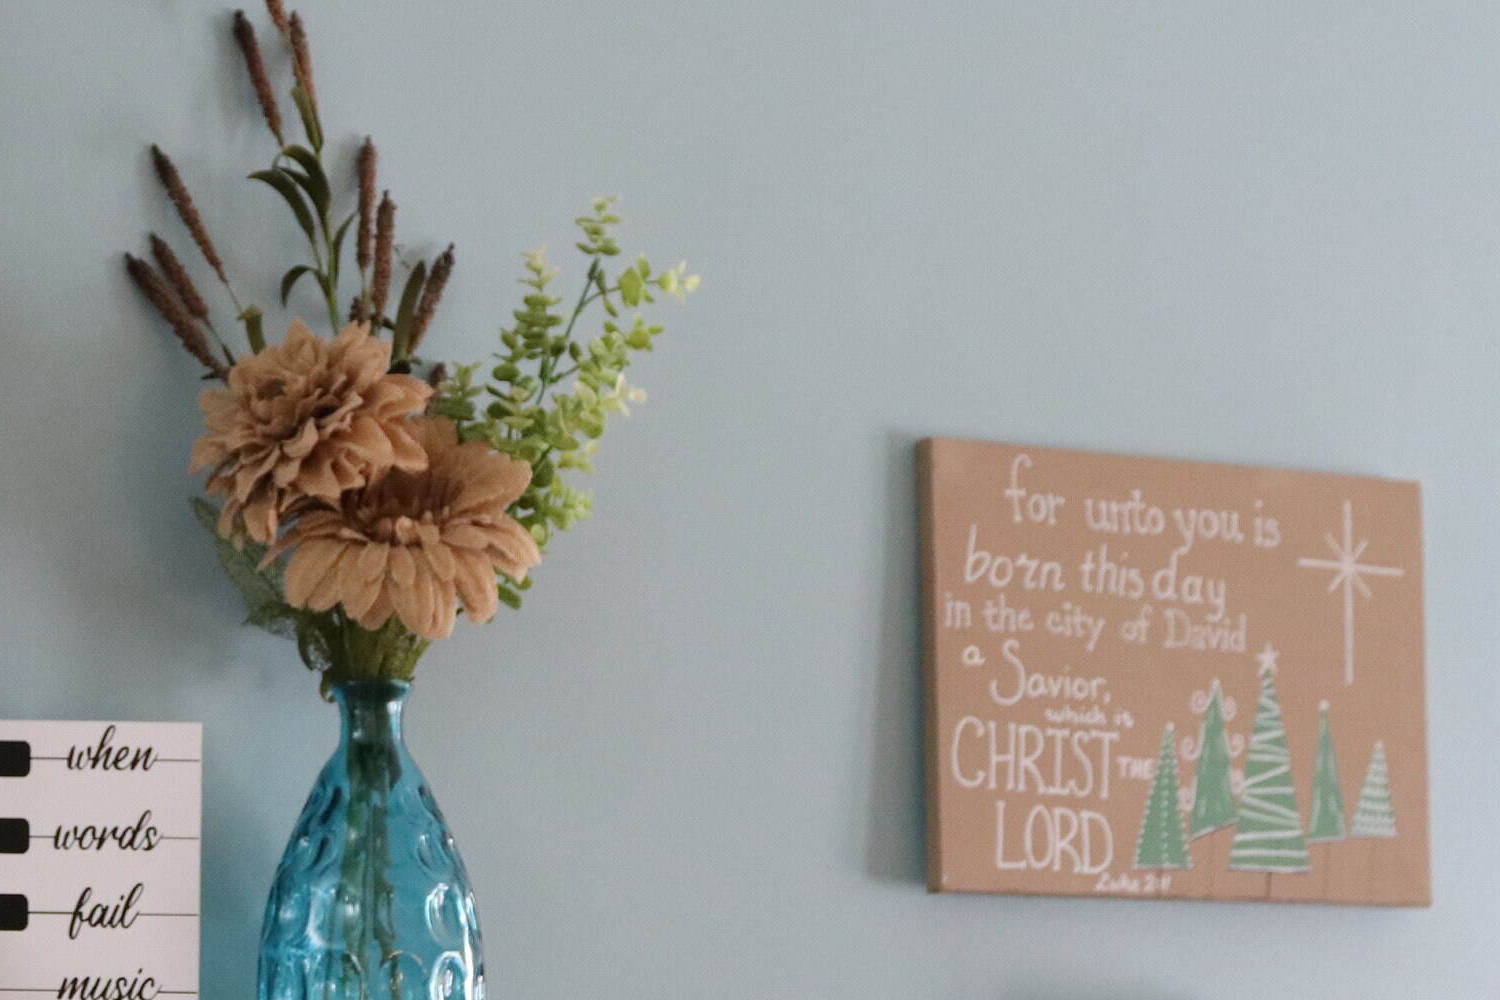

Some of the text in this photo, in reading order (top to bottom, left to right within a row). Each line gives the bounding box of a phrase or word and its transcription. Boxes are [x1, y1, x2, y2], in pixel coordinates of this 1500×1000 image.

[1004, 453, 1282, 556] for unto you is
[964, 524, 1226, 622] born this day
[944, 592, 1248, 653] in the city of David
[961, 638, 1111, 706] a Savior,
[66, 725, 157, 772] when
[950, 716, 1156, 801] CHRIST THE
[53, 810, 162, 852] words
[994, 800, 1114, 875] LORD
[68, 883, 144, 939] fail
